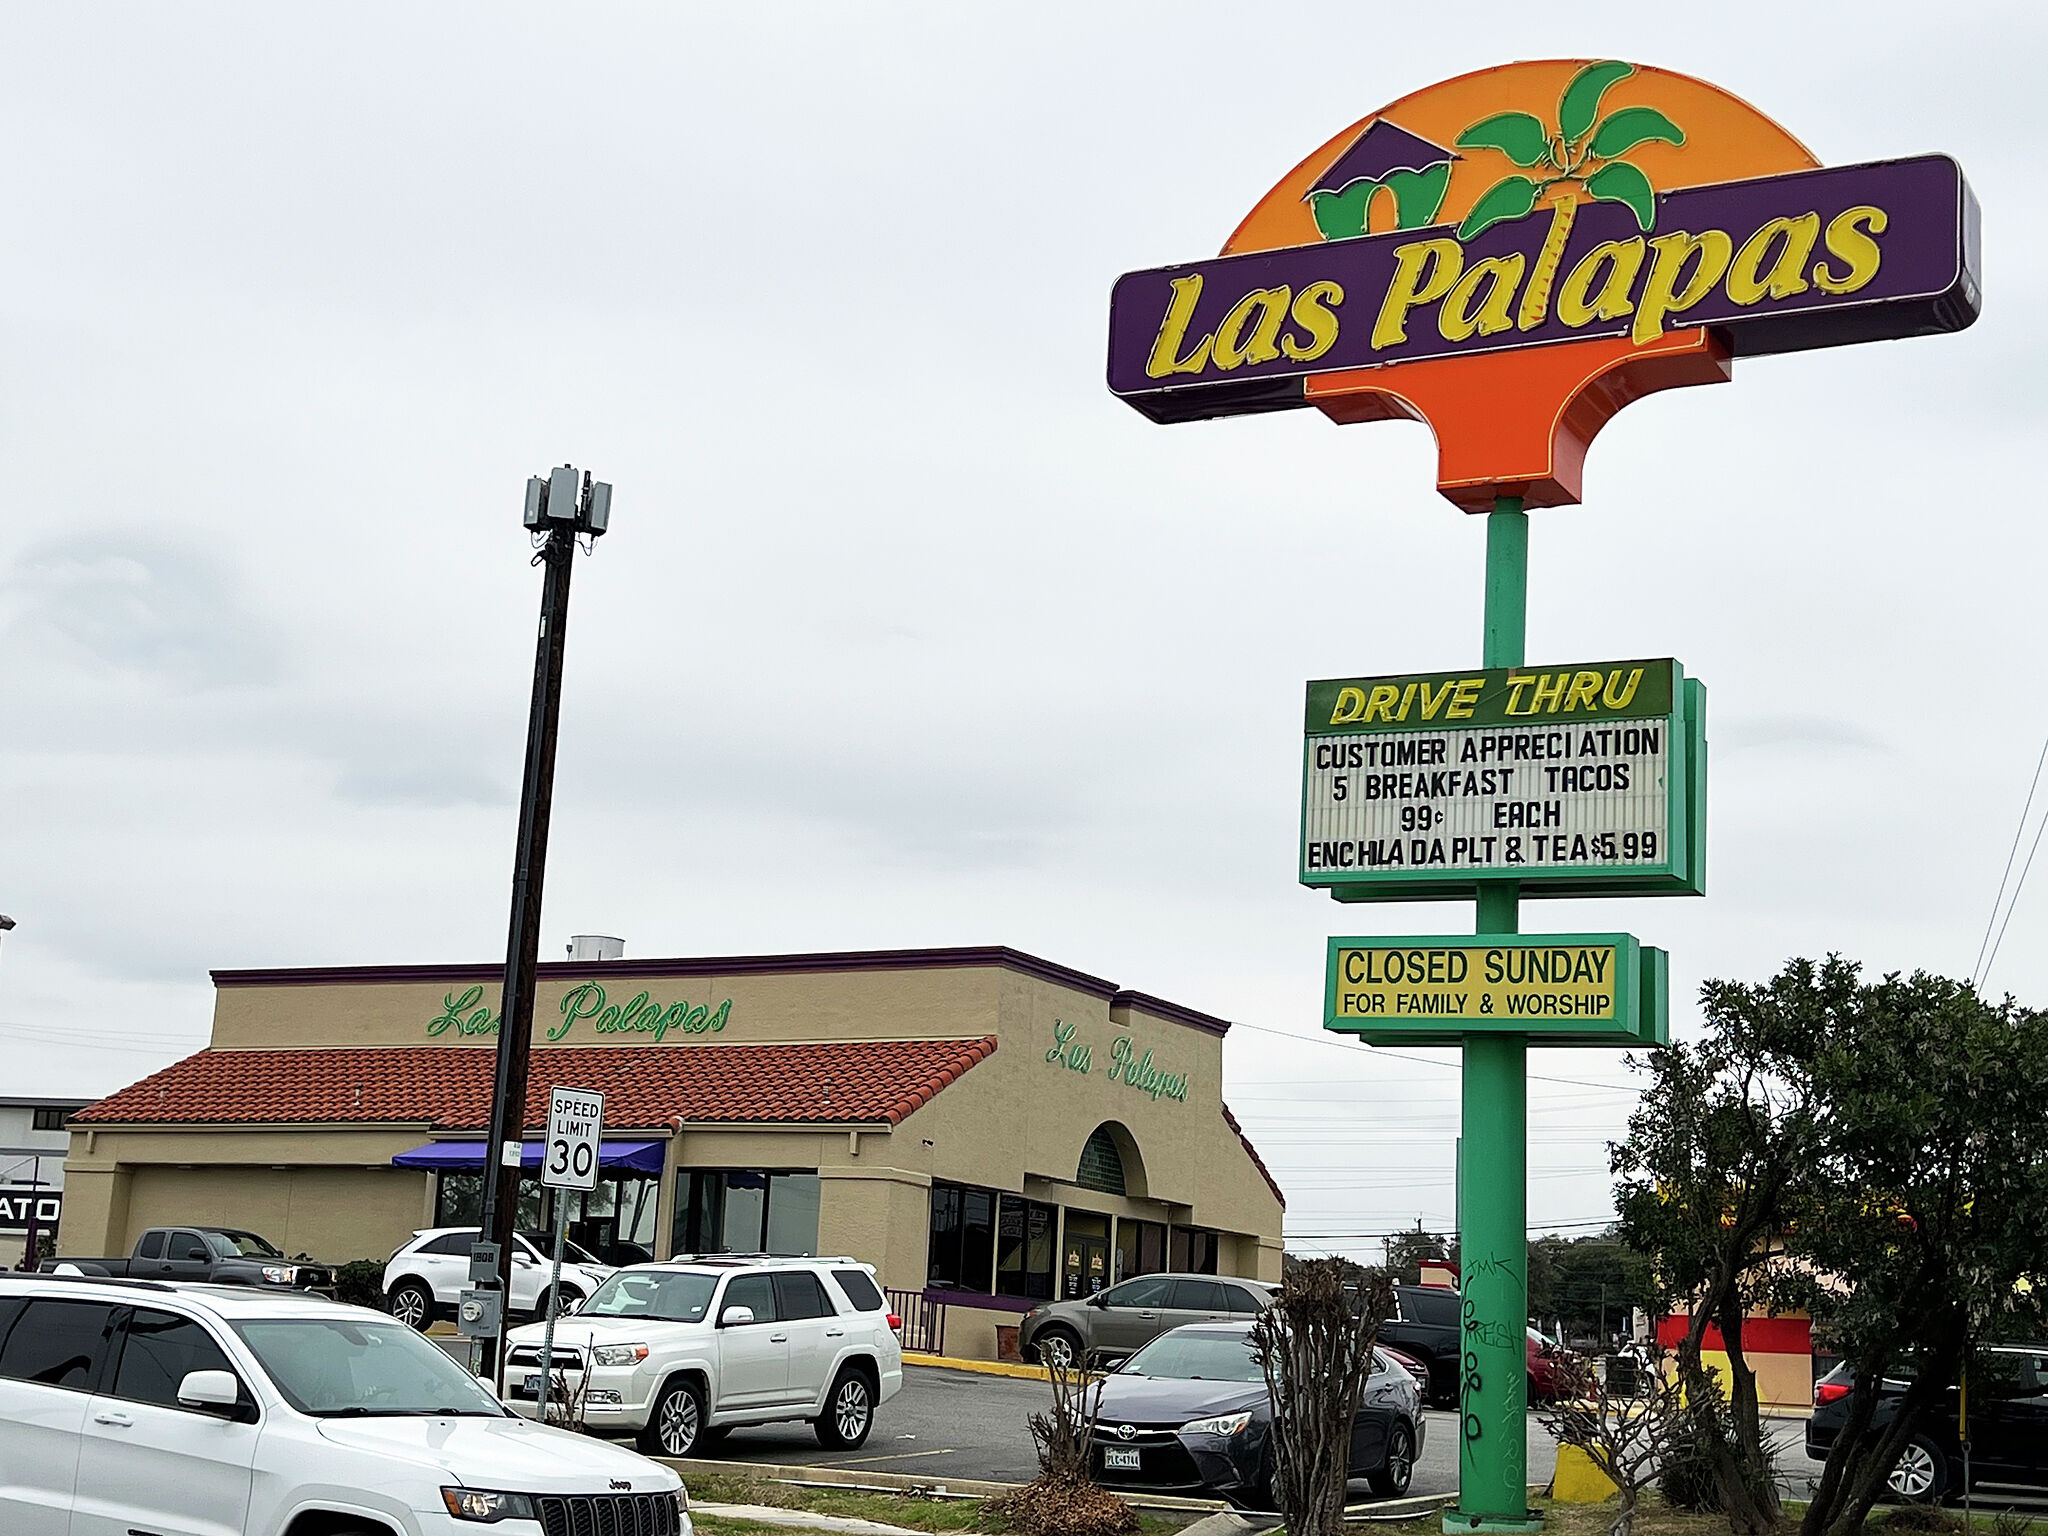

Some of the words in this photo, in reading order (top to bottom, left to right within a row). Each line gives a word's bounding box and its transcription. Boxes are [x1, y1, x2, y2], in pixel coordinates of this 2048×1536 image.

[1145, 273, 1345, 380] Las
[1371, 194, 1889, 350] Palapas
[1329, 678, 1486, 725] DRIVE
[1504, 668, 1645, 716] THRU
[1316, 738, 1447, 770] CUSTOMER
[1460, 727, 1659, 763] APPRECIATION
[1333, 775, 1348, 801] 5
[1365, 767, 1515, 801] BREAKFAST
[1544, 762, 1630, 793] TACOS
[1401, 805, 1444, 832] 99¢
[1493, 800, 1561, 829] EACH
[1451, 836, 1497, 865] PLT
[1505, 836, 1526, 864] &
[1345, 950, 1468, 985] CLOSED
[1484, 949, 1611, 984] SUNDAY
[547, 980, 732, 1043] Palapas
[1343, 993, 1386, 1014] FOR
[1396, 993, 1468, 1014] FAMILY
[1479, 993, 1494, 1014] &
[1506, 994, 1610, 1015] WORSHIP
[1045, 1018, 1093, 1075] Las
[1107, 1035, 1190, 1103] Palapas
[554, 1099, 599, 1118] SPEED
[557, 1119, 592, 1137] LIMIT
[549, 1139, 593, 1177] 30
[609, 1478, 632, 1491] Jeep
